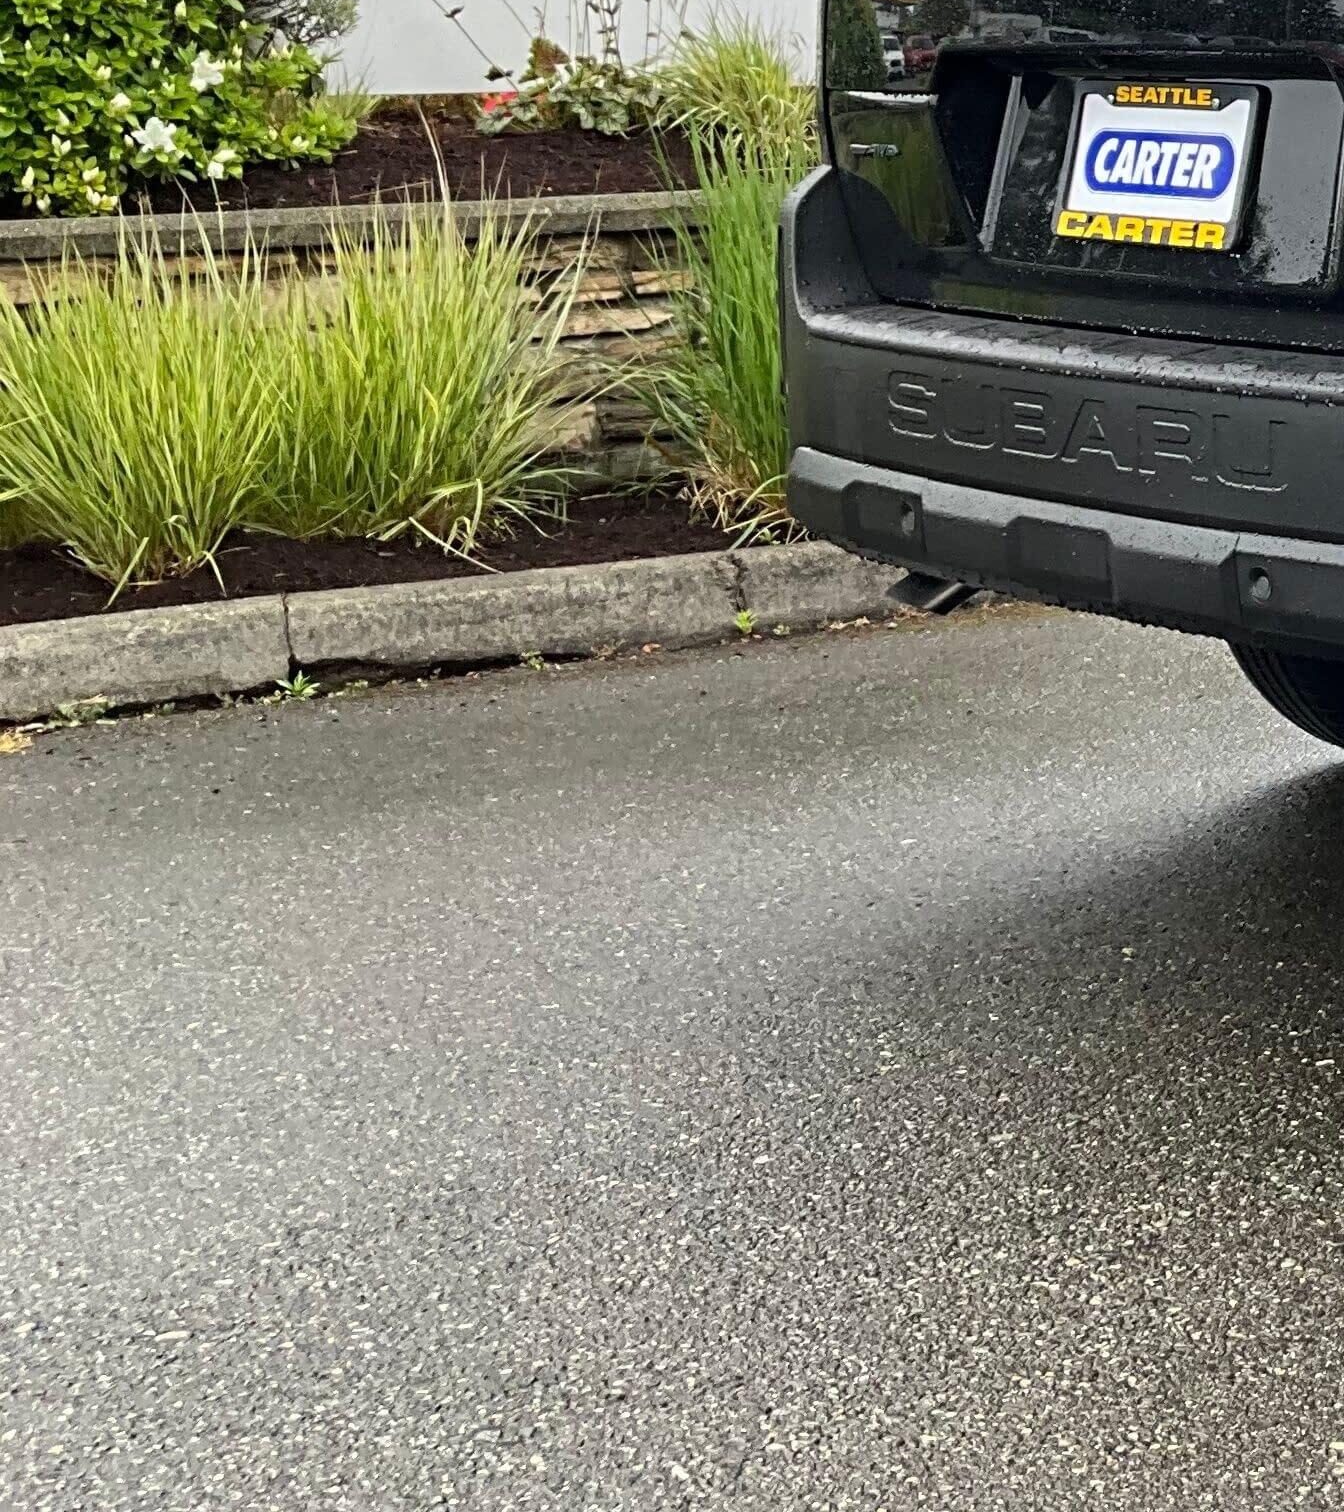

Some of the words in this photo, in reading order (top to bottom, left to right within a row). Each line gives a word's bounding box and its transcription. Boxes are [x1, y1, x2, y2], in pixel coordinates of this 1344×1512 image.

[1116, 86, 1213, 106] SEATTLE
[1094, 137, 1221, 189] CARTER
[1056, 209, 1226, 250] CARTER
[887, 369, 1289, 492] SUBARU
